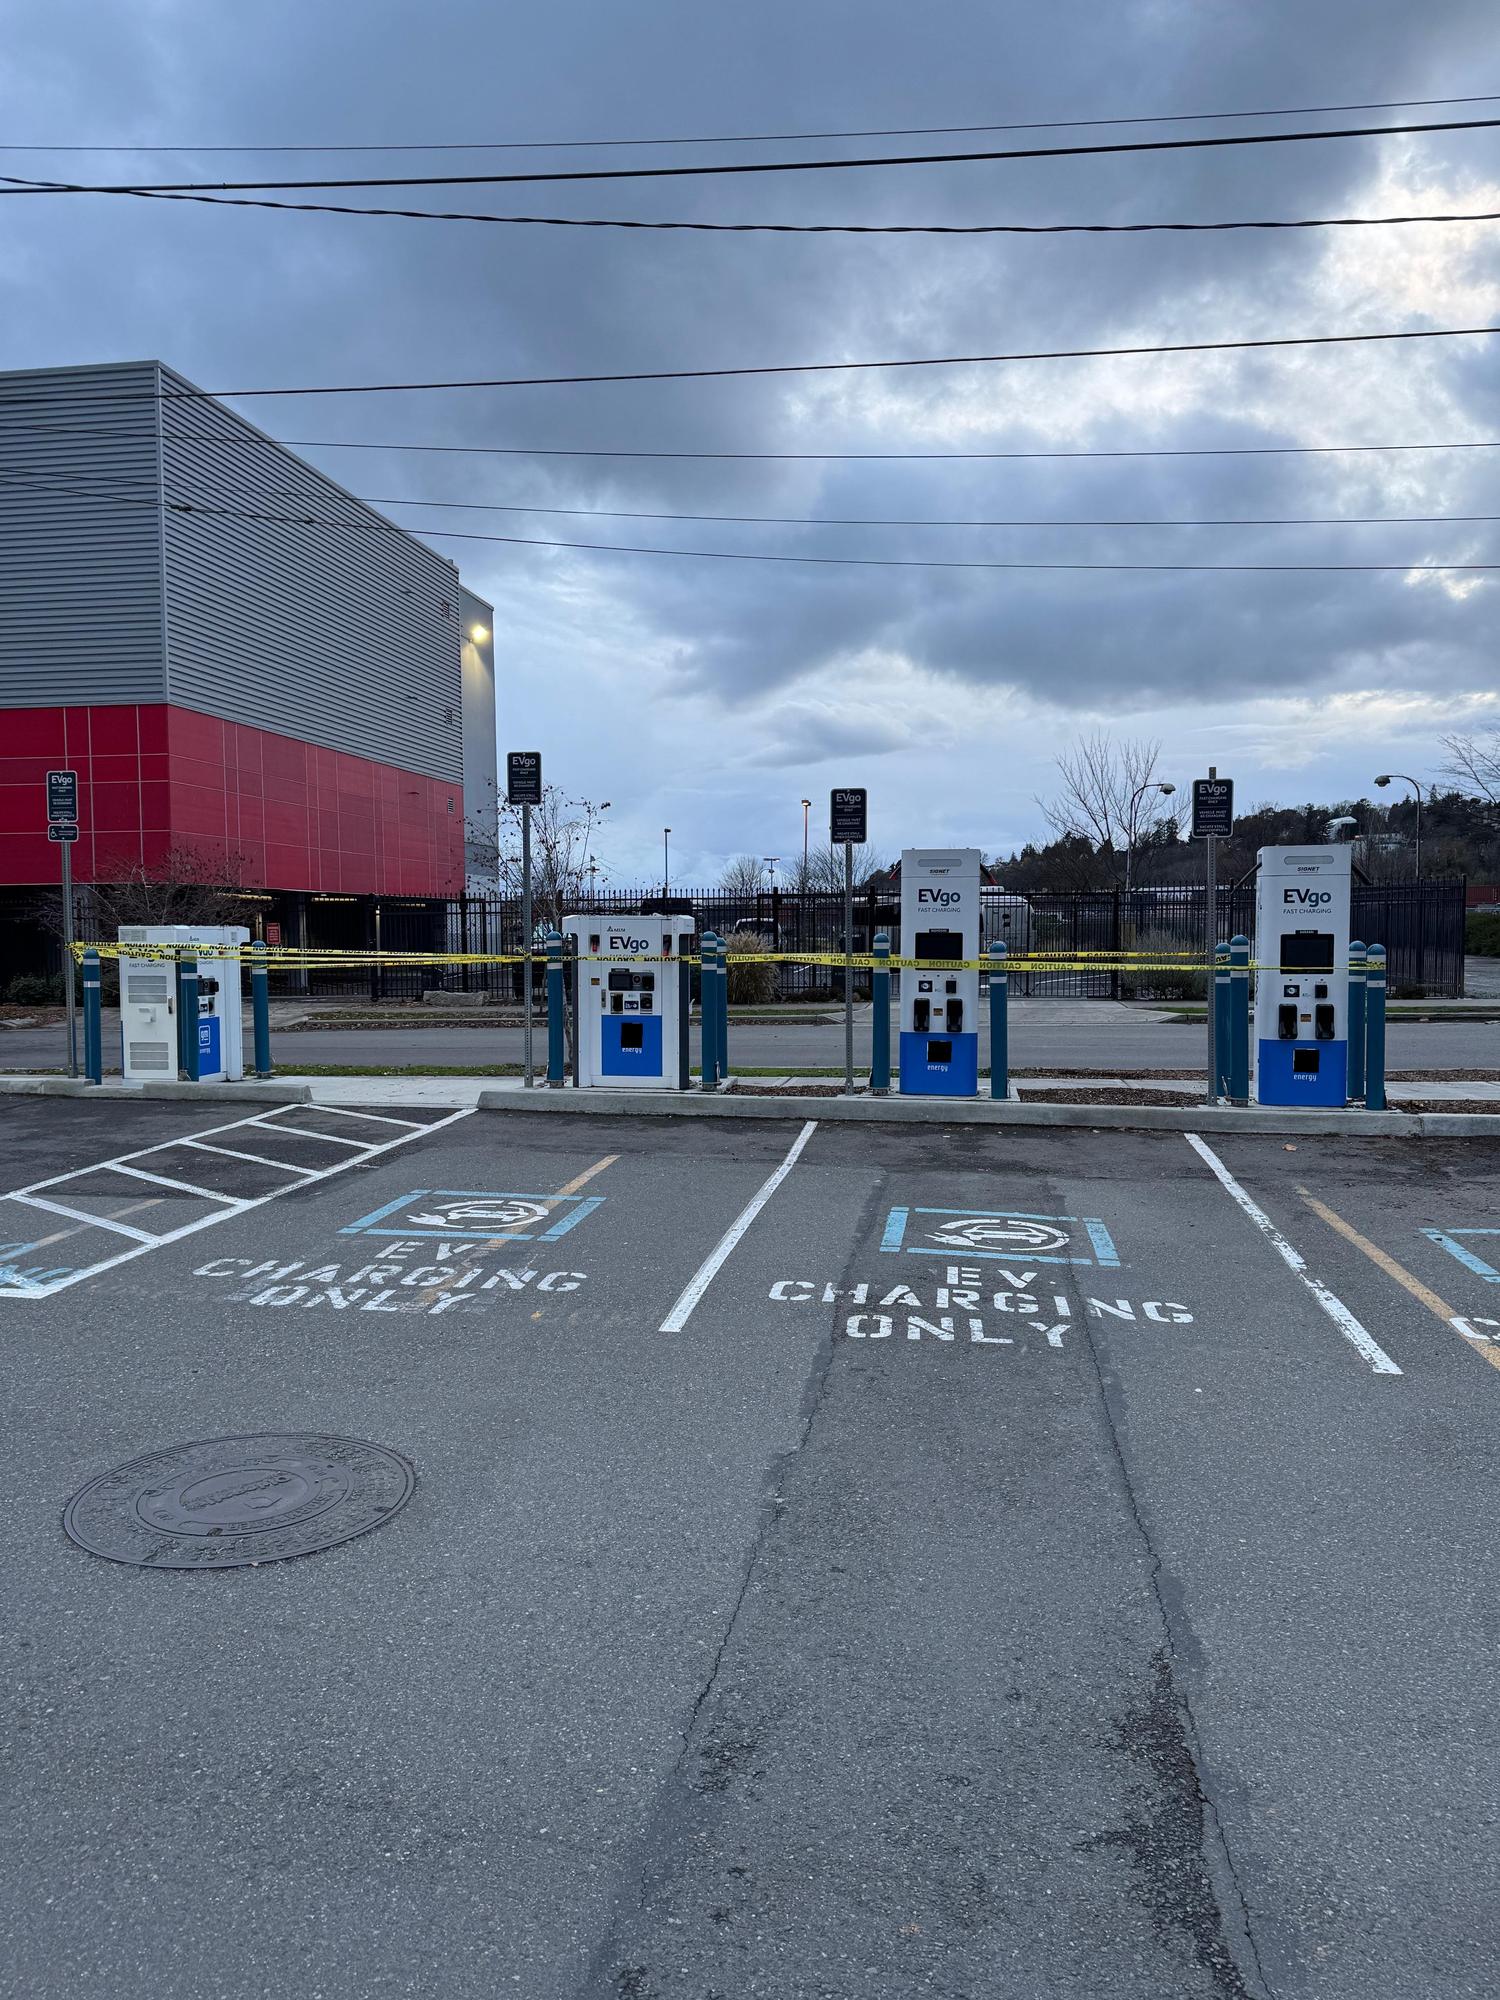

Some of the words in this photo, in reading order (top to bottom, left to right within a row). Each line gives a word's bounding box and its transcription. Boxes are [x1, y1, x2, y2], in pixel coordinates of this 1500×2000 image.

[512, 756, 536, 767] EVgo
[51, 775, 73, 785] EVgo
[836, 793, 861, 804] EVgo
[1199, 784, 1227, 796] EVgo
[918, 888, 961, 907] EVgo
[1283, 888, 1332, 907] EVgo
[609, 936, 649, 953] EVgo
[621, 1047, 643, 1055] energy
[927, 1064, 949, 1072] energy
[1293, 1074, 1317, 1082] energy
[373, 1240, 478, 1261] EV
[191, 1257, 590, 1293] CHARGING
[945, 1265, 1039, 1289] EV
[248, 1285, 478, 1315] ONLY
[767, 1280, 1195, 1324] CHARGING
[845, 1313, 1073, 1348] ONLY
